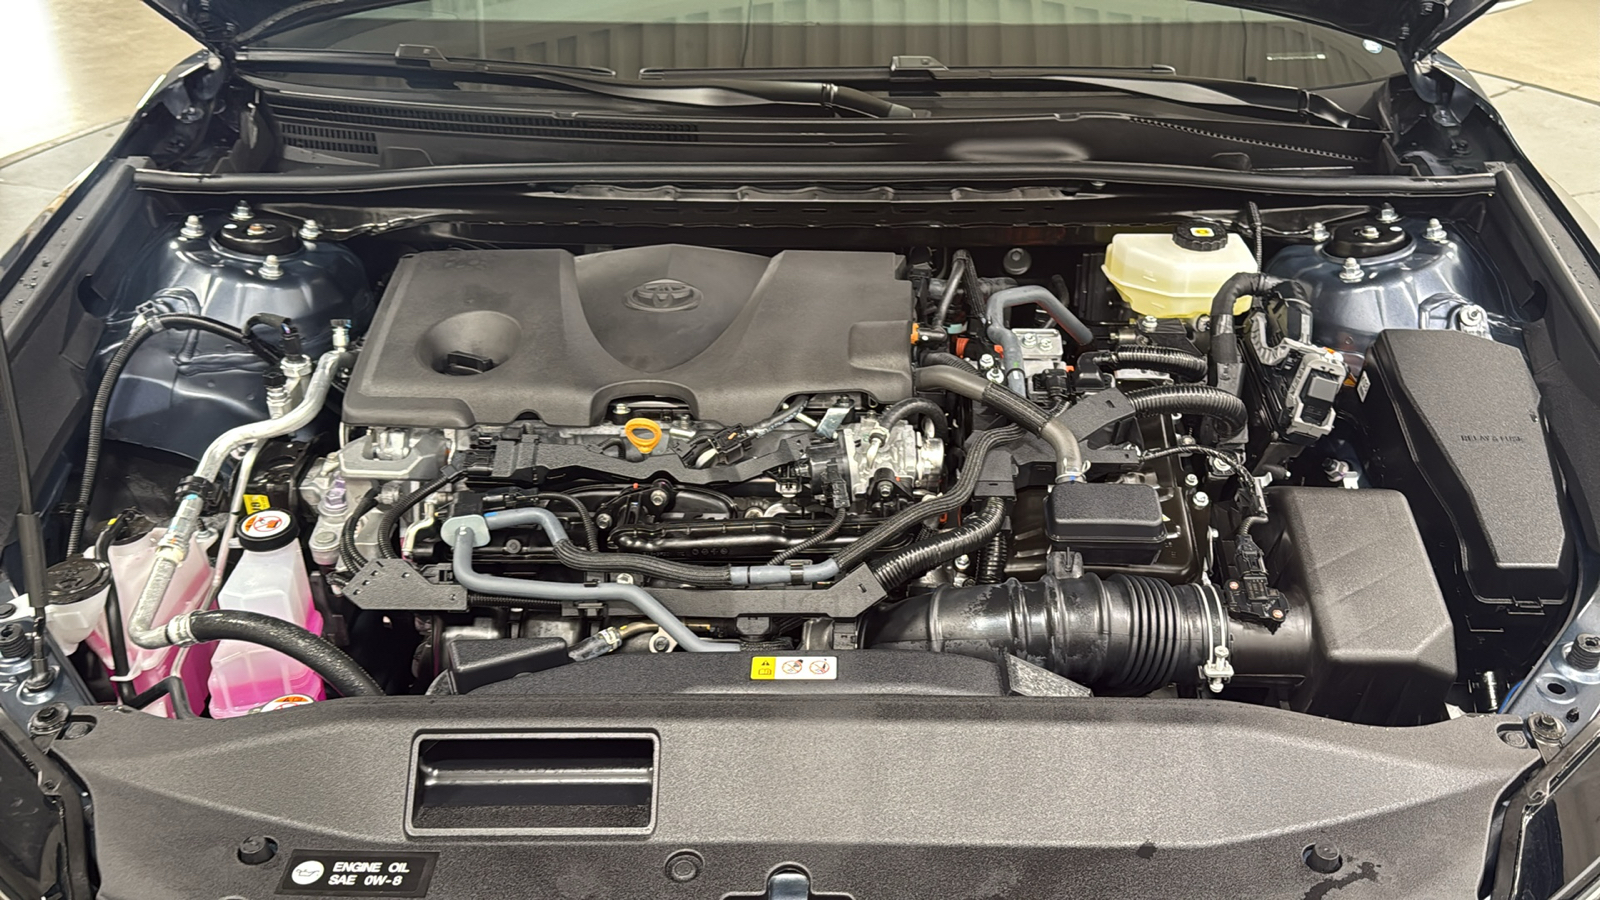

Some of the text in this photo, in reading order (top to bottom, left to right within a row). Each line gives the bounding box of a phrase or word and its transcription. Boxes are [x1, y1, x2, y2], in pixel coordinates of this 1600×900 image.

[332, 861, 410, 873] ENGINE OIL
[328, 874, 403, 886] SAE 0W-8
